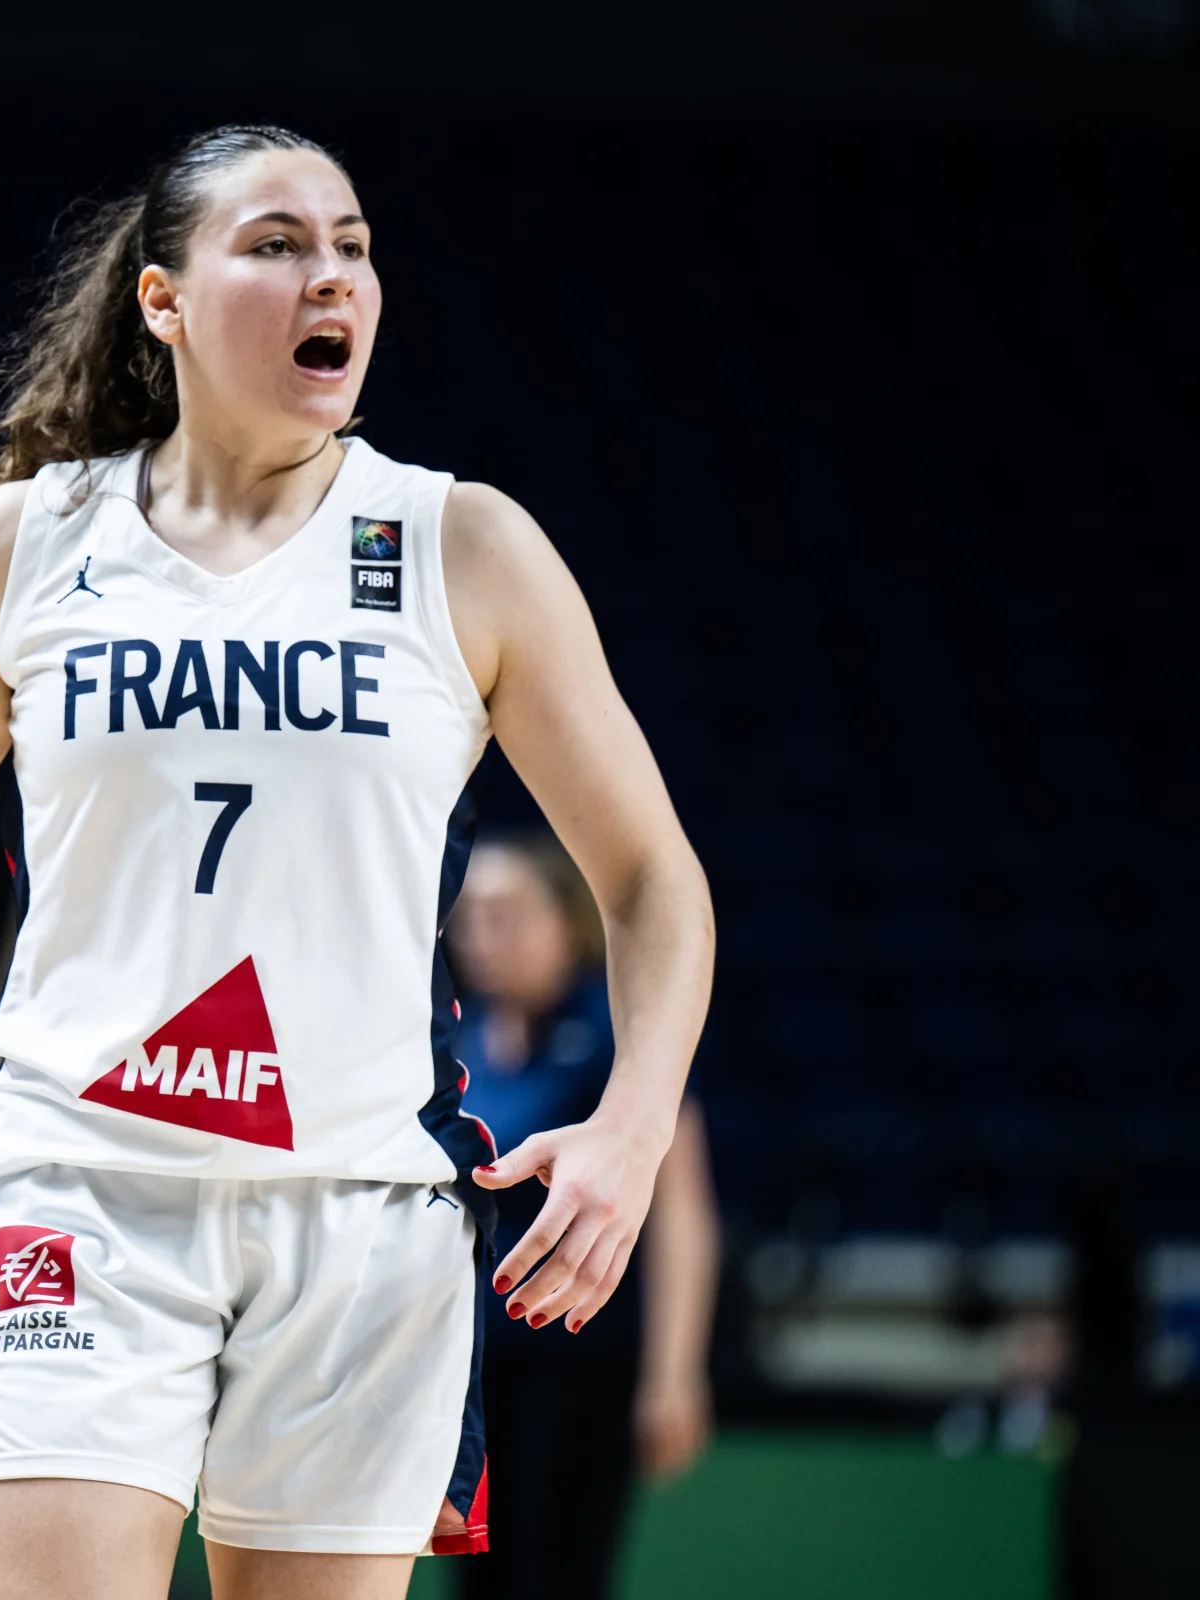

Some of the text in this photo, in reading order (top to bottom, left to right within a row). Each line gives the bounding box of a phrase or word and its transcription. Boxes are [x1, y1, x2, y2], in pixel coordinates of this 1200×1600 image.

[358, 570, 394, 588] FIBA
[63, 638, 391, 741] FRANCE
[194, 782, 253, 895] 7
[121, 1045, 280, 1104] MAIF
